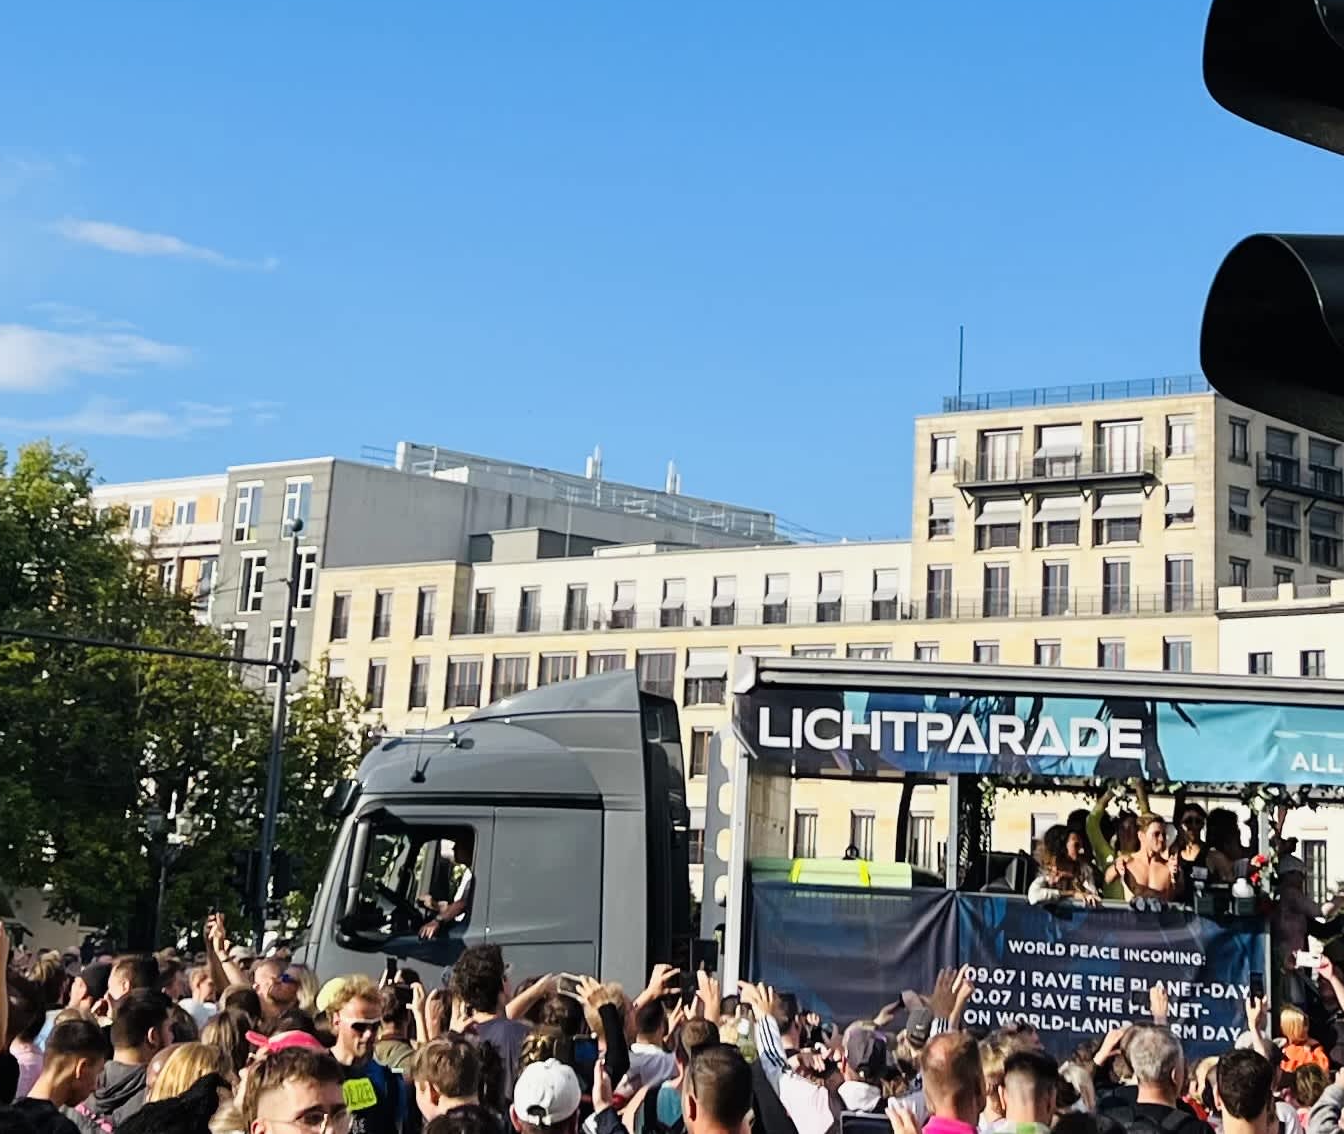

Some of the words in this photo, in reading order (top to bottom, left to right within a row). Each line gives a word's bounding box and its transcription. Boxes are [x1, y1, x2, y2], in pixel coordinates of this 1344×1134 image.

[758, 706, 1145, 759] LICHTPARADE
[1008, 939, 1066, 957] WORLD
[1070, 944, 1120, 961] PEACE
[1123, 948, 1206, 967] INCOMING:
[965, 966, 1016, 986] 09.07
[1031, 971, 1084, 990] RAVE
[1088, 975, 1125, 993] THE
[967, 988, 1012, 1006] 0.07
[1031, 992, 1082, 1011] SAVE
[1086, 996, 1123, 1014] THE
[1128, 999, 1210, 1018] PLNET-
[963, 1009, 991, 1026] ON
[1202, 1026, 1241, 1042] DAY
